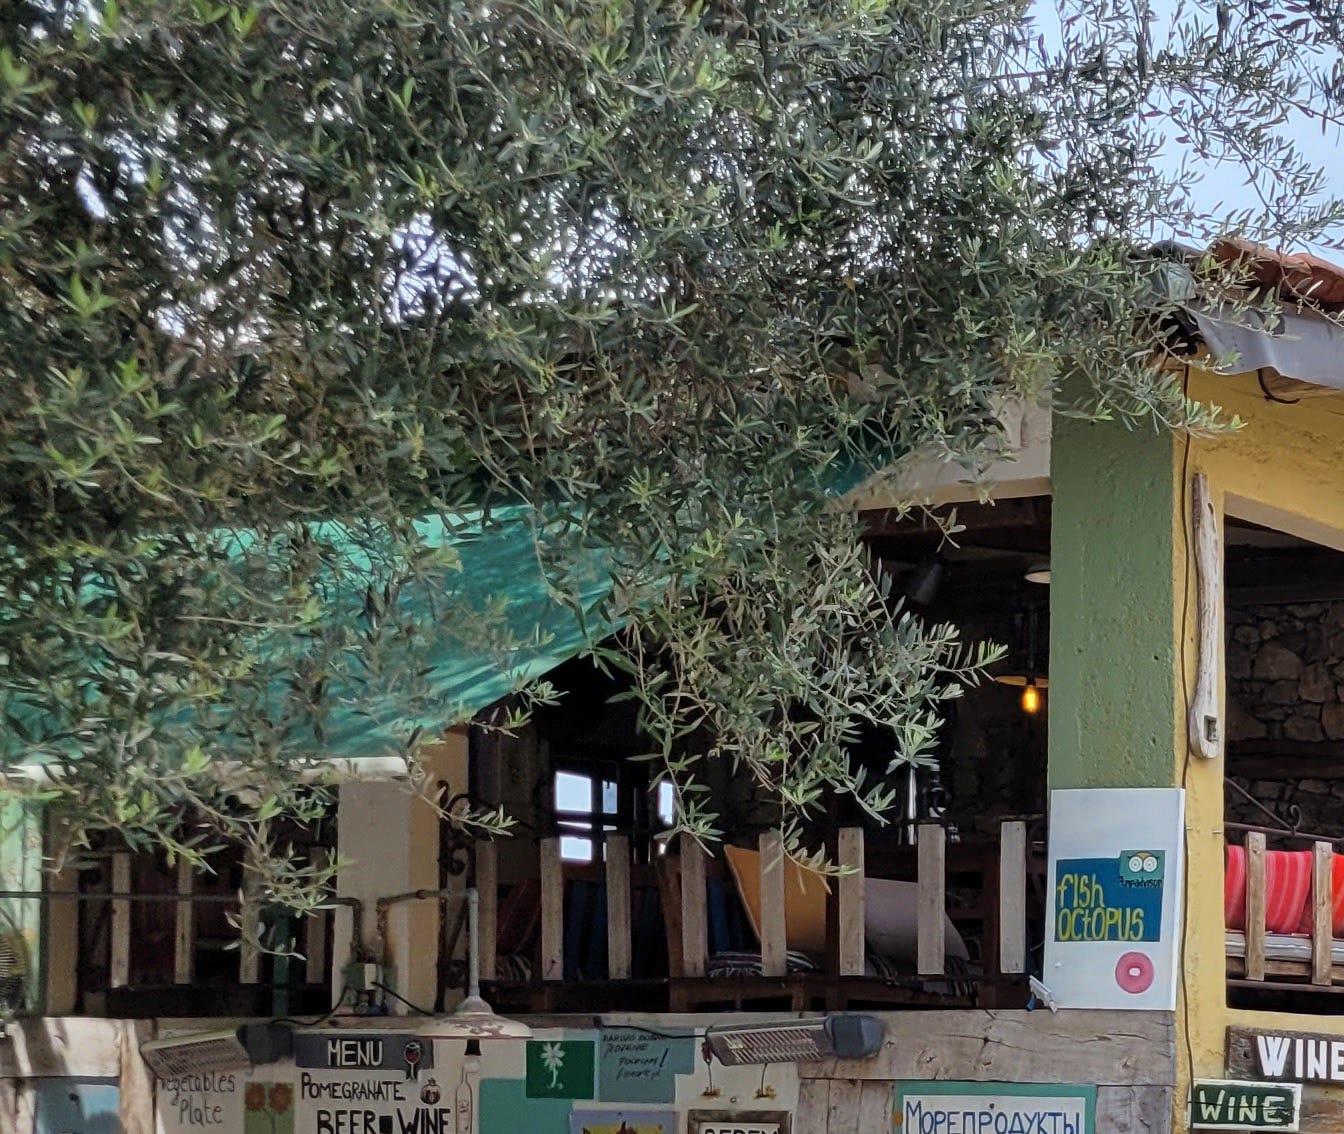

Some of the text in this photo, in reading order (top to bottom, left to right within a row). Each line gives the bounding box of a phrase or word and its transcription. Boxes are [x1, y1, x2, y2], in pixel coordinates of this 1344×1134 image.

[327, 1039, 383, 1066] MENU
[180, 1095, 224, 1127] Plate
[1199, 1089, 1286, 1123] WINE
